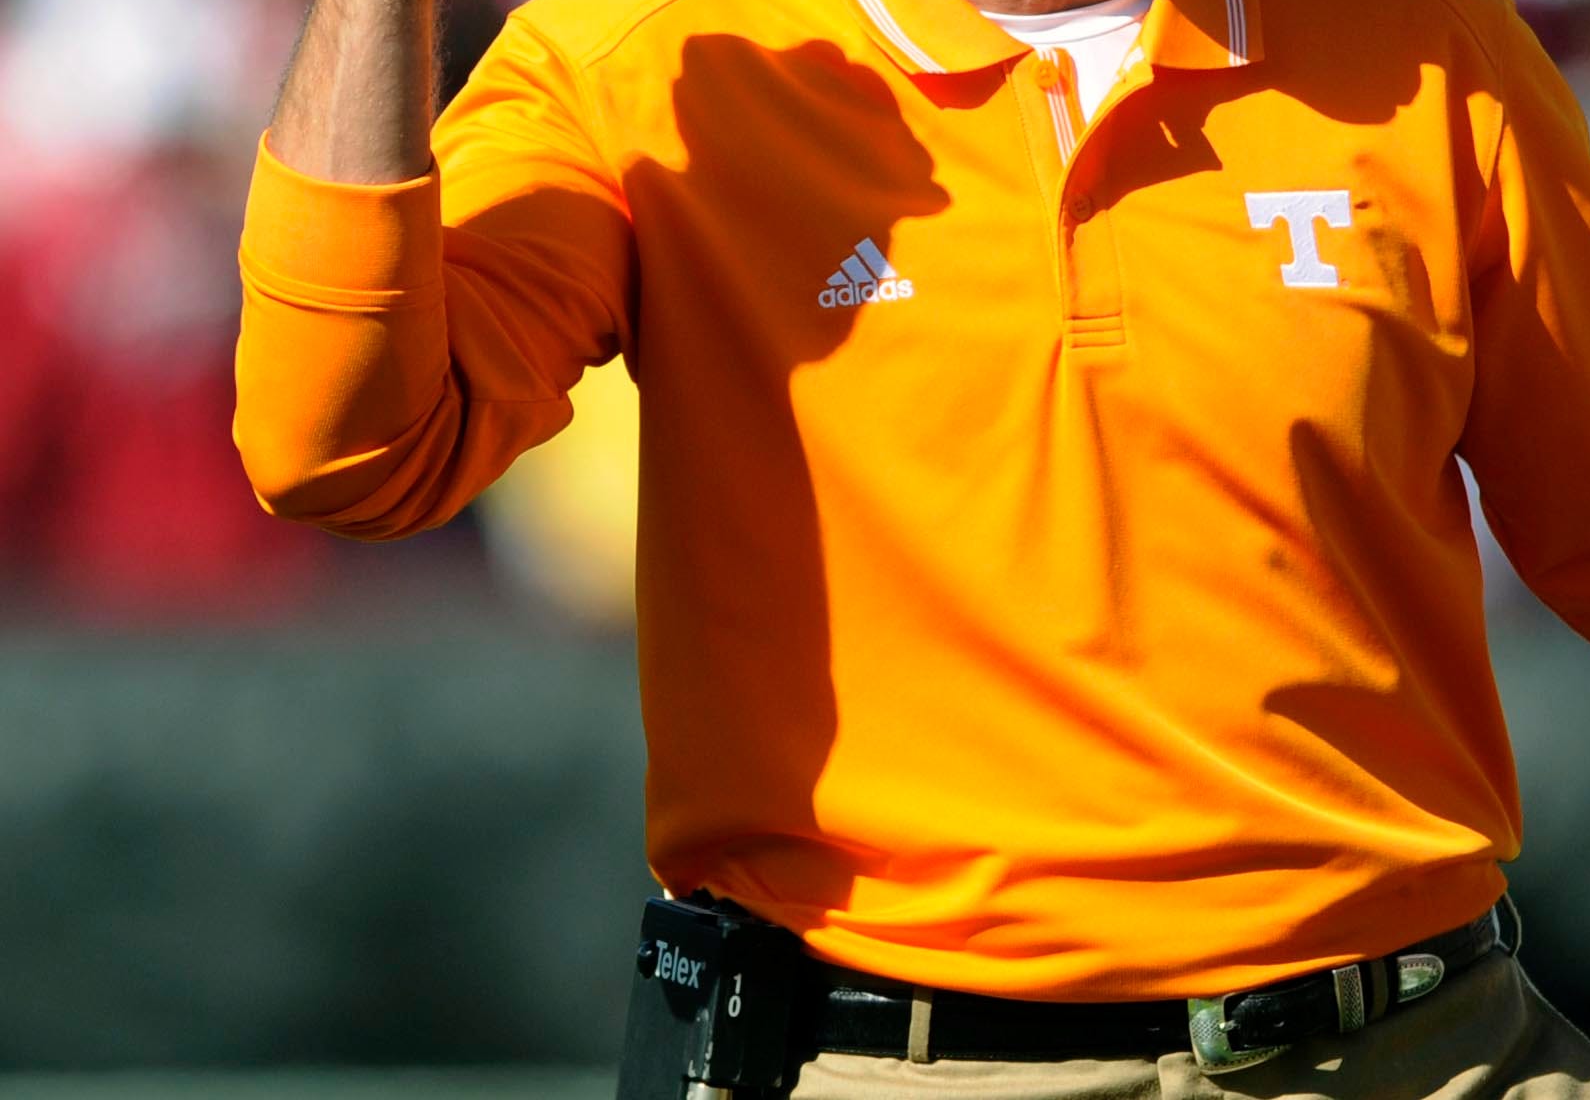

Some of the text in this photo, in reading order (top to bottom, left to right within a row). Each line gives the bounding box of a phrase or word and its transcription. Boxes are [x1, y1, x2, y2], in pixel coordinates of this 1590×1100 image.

[1244, 189, 1351, 286] T
[818, 279, 913, 308] adidas
[655, 939, 701, 989] Telex
